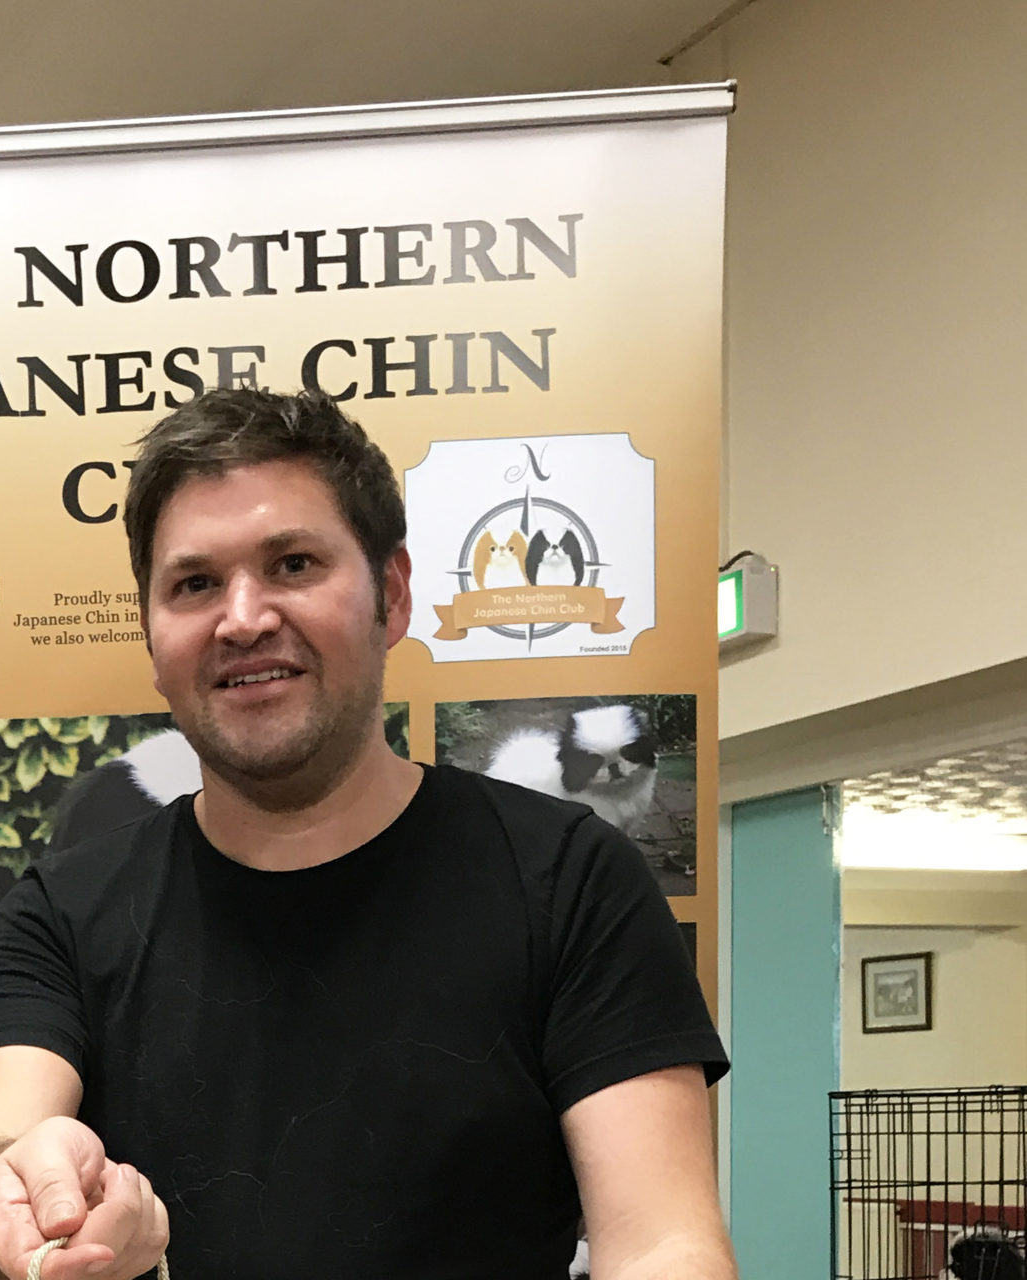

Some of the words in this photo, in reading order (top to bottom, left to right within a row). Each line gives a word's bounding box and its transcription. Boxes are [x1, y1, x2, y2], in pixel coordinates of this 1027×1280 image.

[14, 212, 585, 309] NORTHERN
[301, 327, 557, 403] CHIN
[504, 442, 551, 484] N
[53, 590, 112, 607] Proudly
[115, 591, 141, 605] sup
[491, 594, 512, 605] The
[516, 591, 567, 604] Northern
[13, 613, 81, 630] Japanese
[85, 609, 120, 625] Chin
[124, 608, 140, 623] in
[473, 604, 527, 619] Japanese
[531, 602, 557, 615] Chin
[560, 601, 585, 614] Club
[30, 634, 51, 646] we
[55, 631, 85, 645] also
